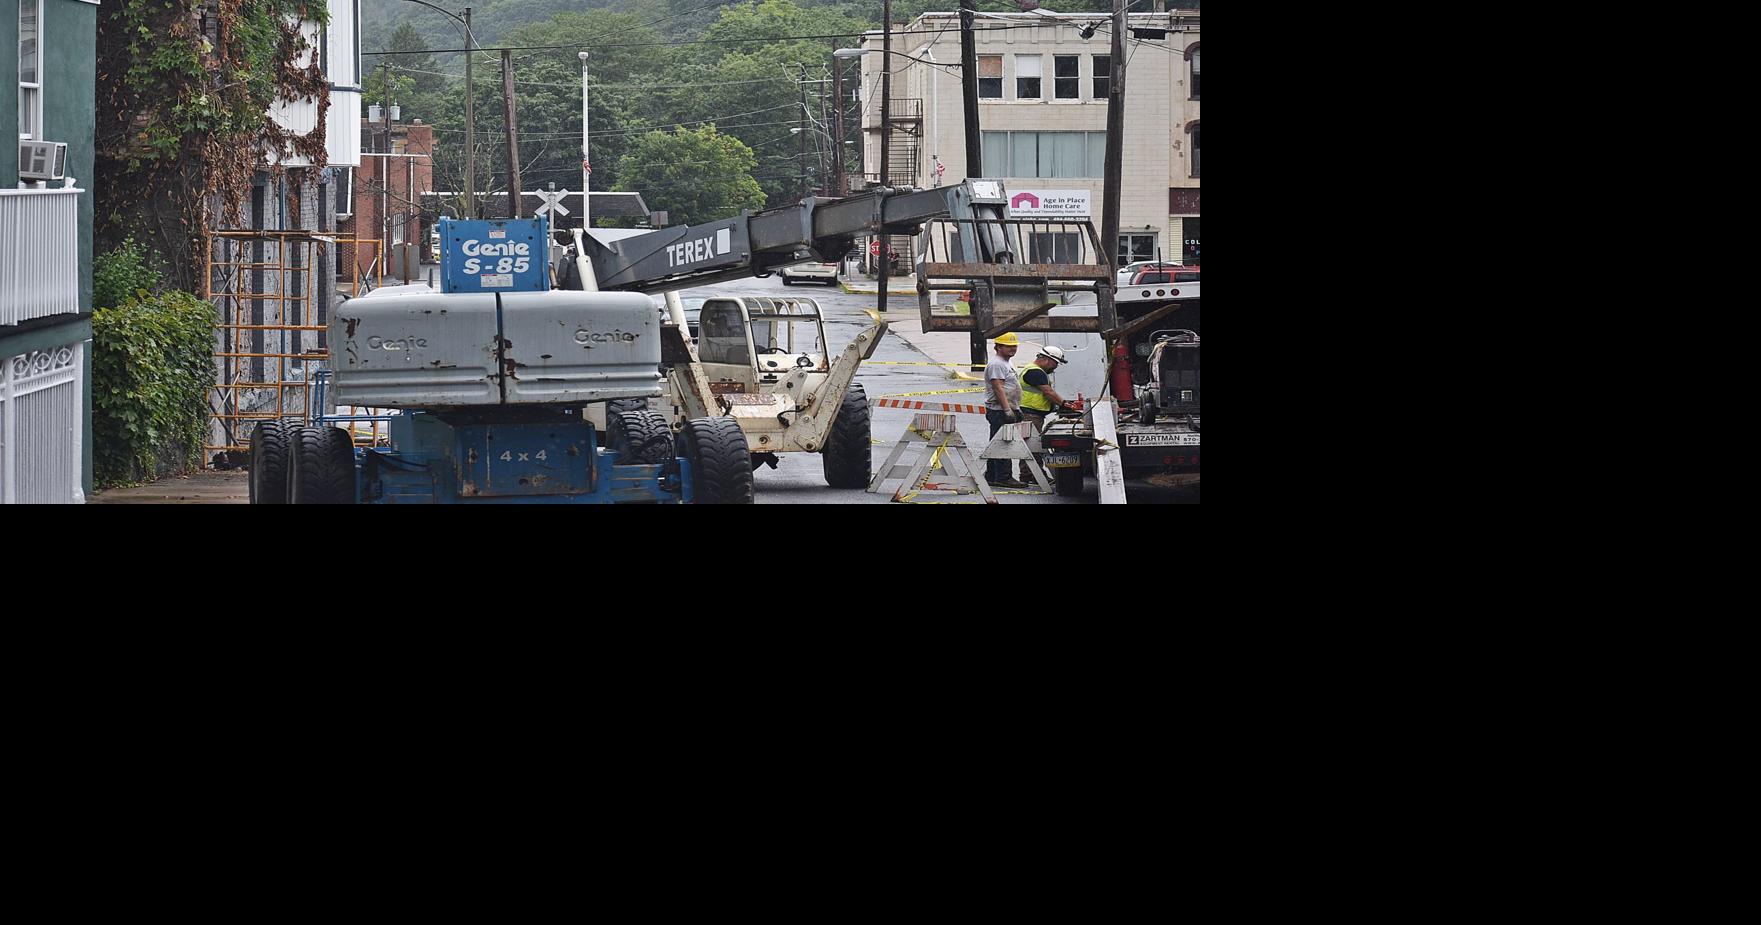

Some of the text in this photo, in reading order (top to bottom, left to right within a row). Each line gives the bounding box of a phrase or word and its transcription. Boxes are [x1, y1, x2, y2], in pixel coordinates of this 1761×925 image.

[462, 239, 530, 256] Genie
[666, 236, 714, 268] TEREX
[367, 335, 428, 351] Genie
[574, 329, 635, 344] Genie
[500, 450, 512, 462] 4
[535, 449, 547, 461] 4
